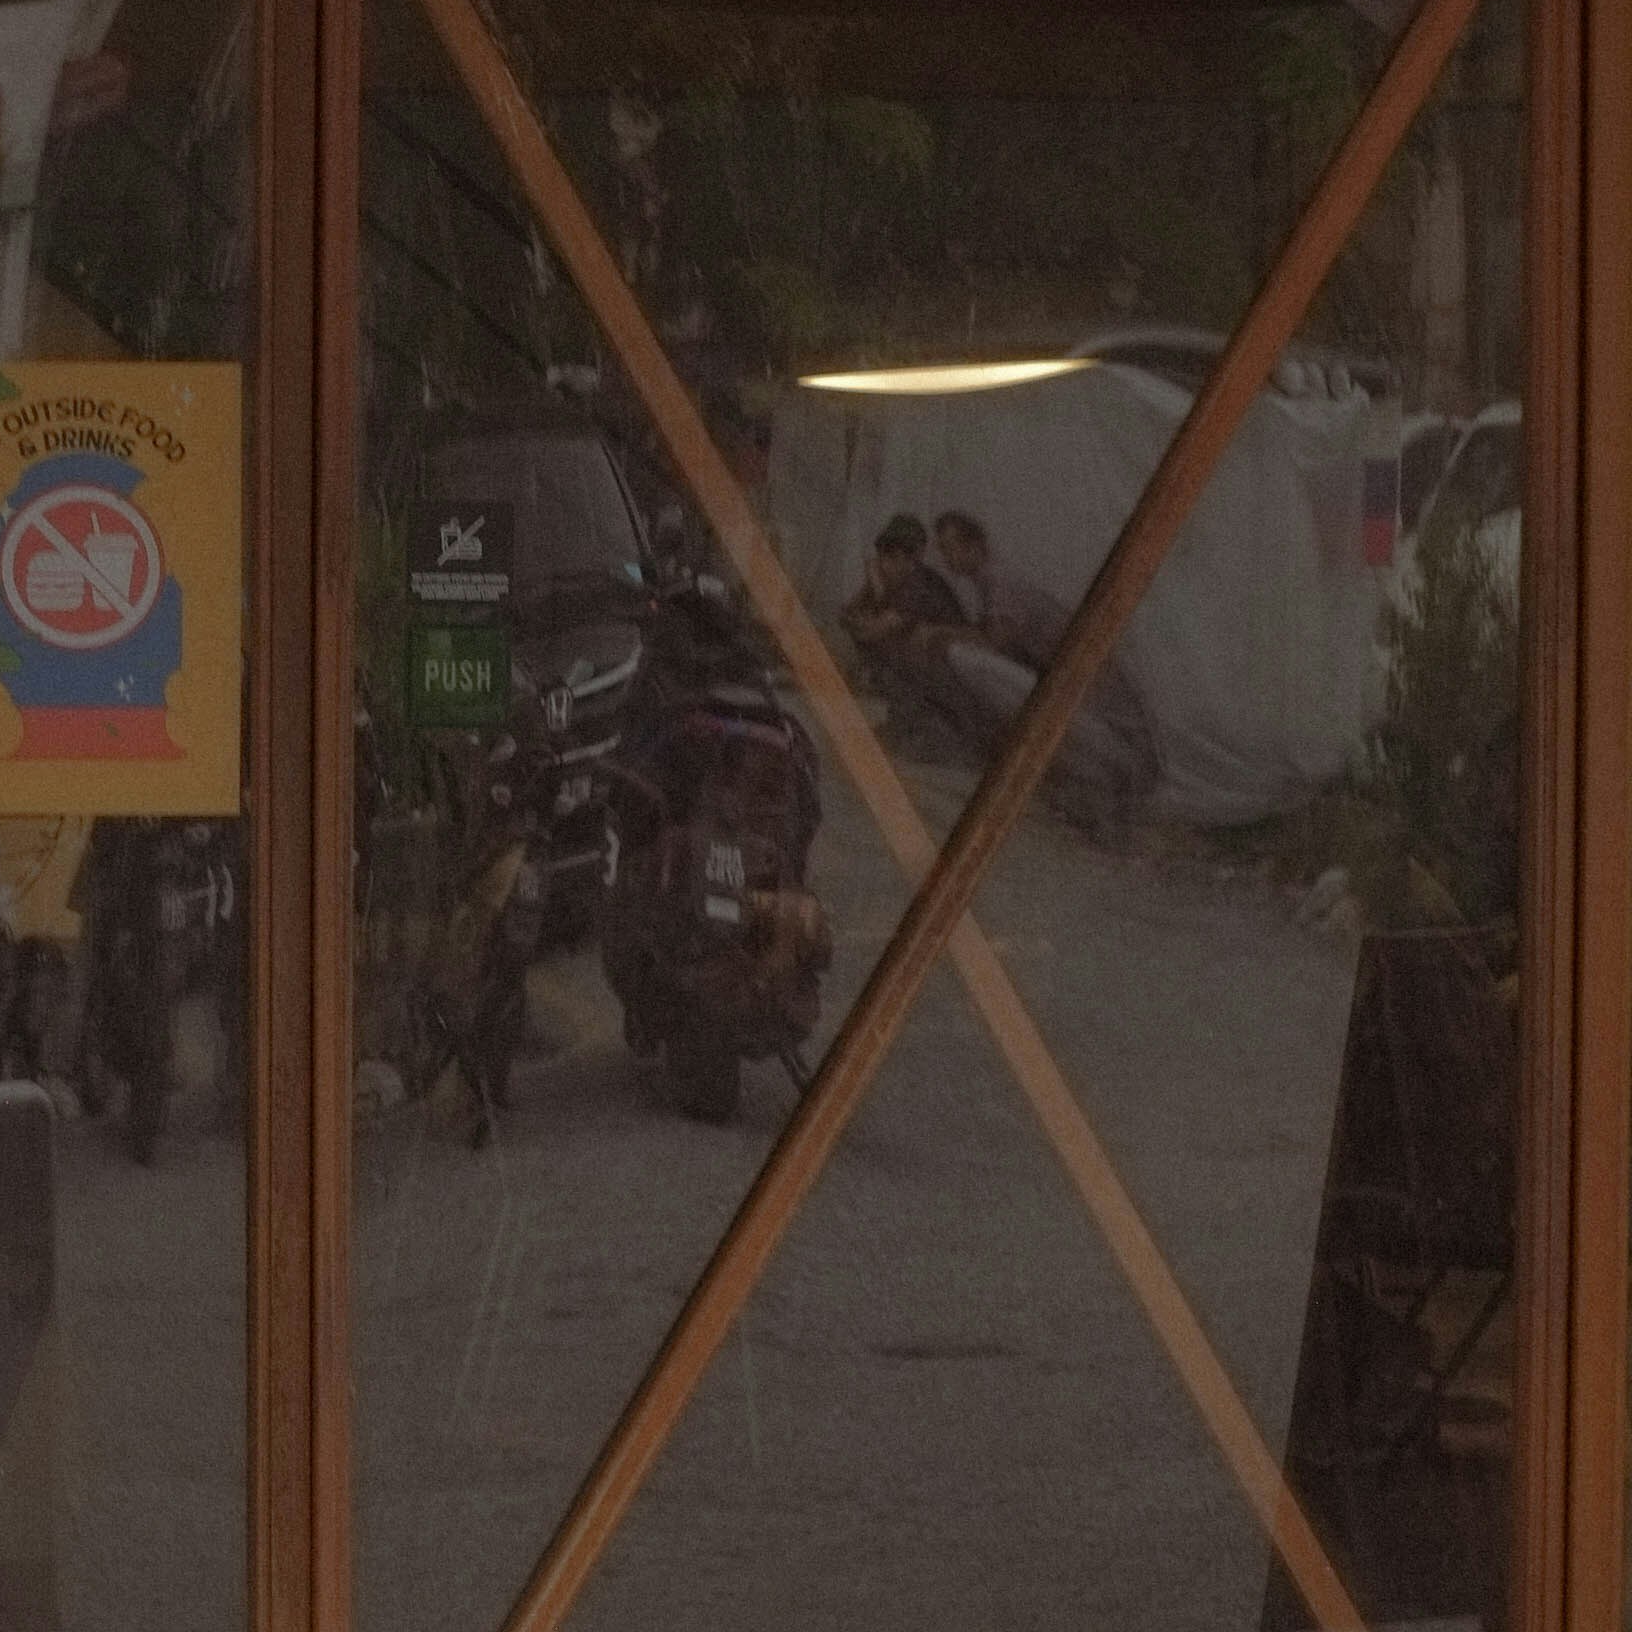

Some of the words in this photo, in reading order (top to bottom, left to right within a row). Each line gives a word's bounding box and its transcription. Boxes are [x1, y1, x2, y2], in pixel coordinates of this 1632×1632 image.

[2, 397, 116, 434] OUTSIDE
[120, 407, 186, 463] FOOD
[42, 428, 136, 459] DRINKS
[424, 659, 491, 693] PUSH
